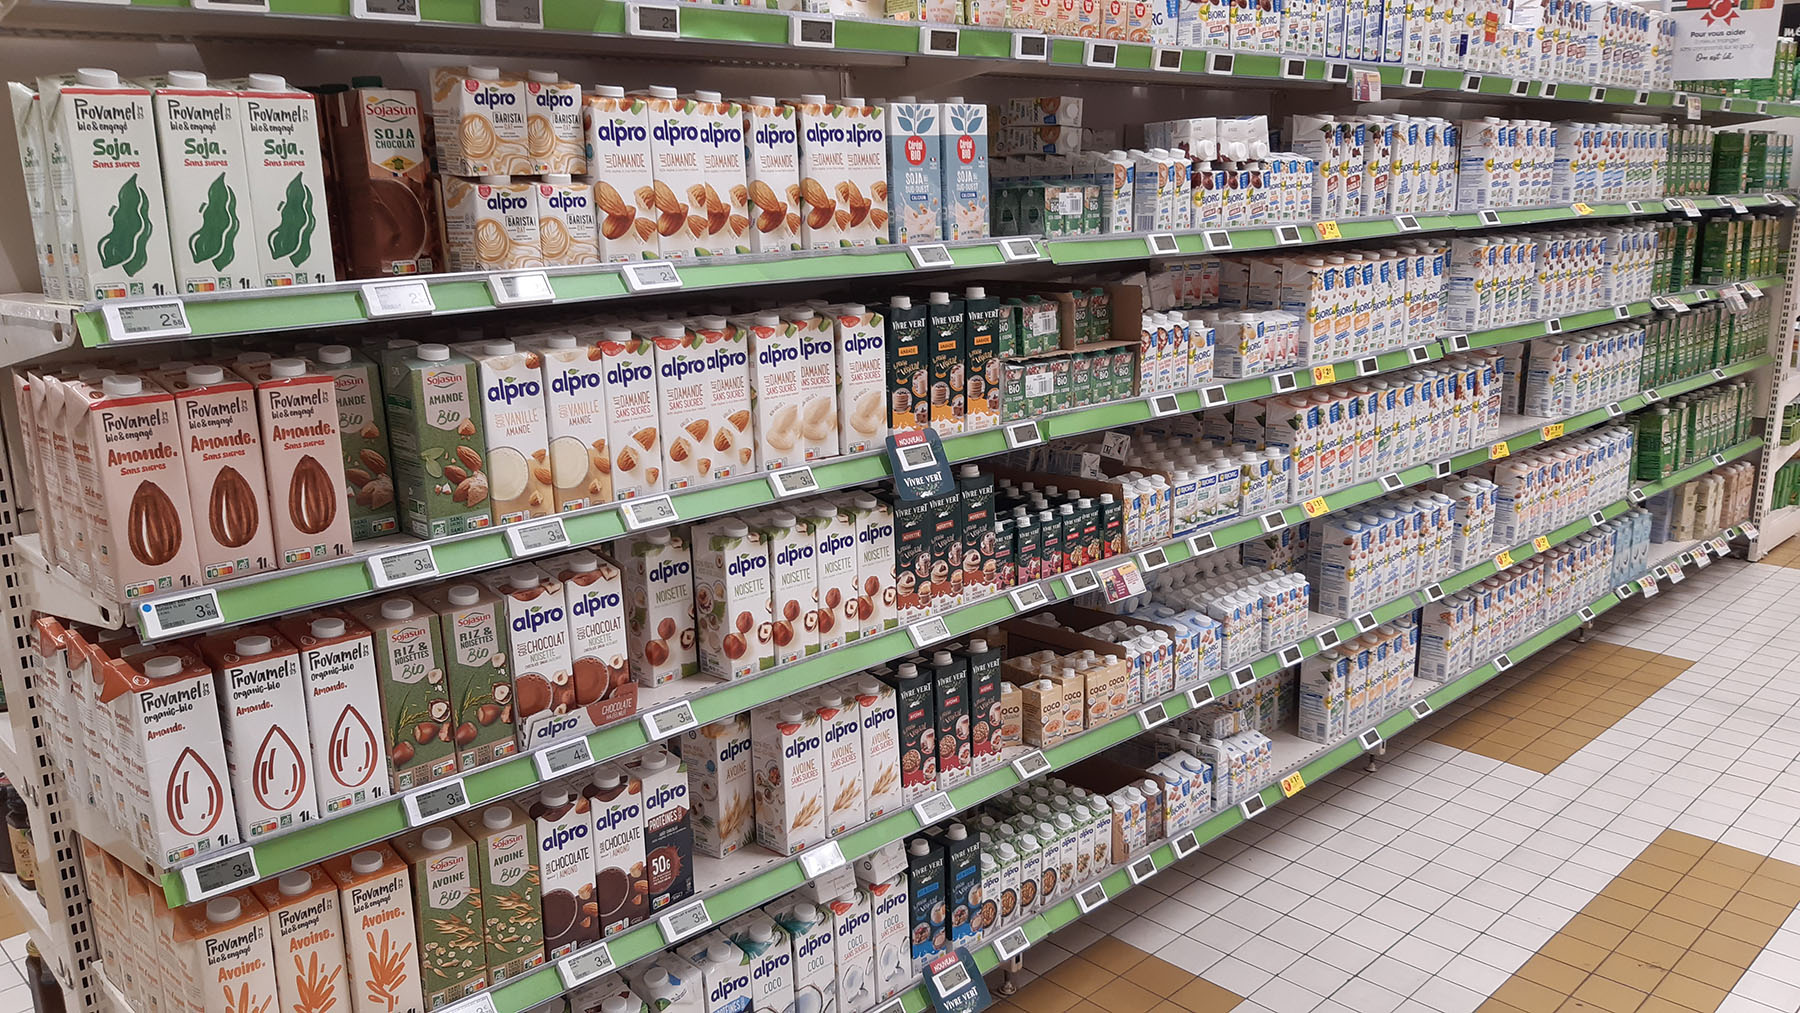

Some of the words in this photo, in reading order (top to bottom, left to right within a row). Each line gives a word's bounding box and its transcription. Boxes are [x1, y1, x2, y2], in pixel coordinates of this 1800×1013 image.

[474, 88, 515, 110] alpro
[536, 90, 574, 110] alpro
[366, 103, 416, 118] Sojasun
[495, 113, 522, 124] BARISTA
[555, 114, 580, 124] BARISTA
[374, 128, 414, 140] SOJA
[598, 119, 646, 146] alpro
[653, 119, 698, 146] alpro
[700, 122, 741, 148] alpro
[756, 124, 795, 149] alpro
[806, 122, 844, 147] alpro
[376, 139, 415, 149] CHOCOLAT
[911, 151, 921, 160] BIO
[962, 150, 970, 159] BIO
[906, 172, 924, 184] SOJA
[957, 171, 973, 182] SOJA
[487, 192, 528, 213] alpro
[550, 191, 586, 212] alpro
[508, 216, 534, 226] BARISTA
[568, 214, 593, 226] BARISTA
[660, 272, 668, 282] 2
[160, 314, 172, 326] 2
[908, 318, 926, 328] VERT
[948, 313, 963, 323] VERT
[426, 374, 462, 386] Sojasun
[552, 371, 600, 396] alpro
[488, 377, 540, 404] alpro
[713, 392, 725, 402] SANS
[726, 390, 744, 400] SUCRES
[430, 392, 464, 405] AMANDE
[670, 400, 682, 410] SANS
[684, 398, 703, 408] SUCRES
[568, 400, 599, 416] VANILLE
[616, 408, 629, 419] SANS
[631, 405, 650, 416] SUCRES
[437, 410, 460, 424] Bio
[505, 409, 538, 426] VANILLE
[569, 416, 592, 426] AMANDE
[506, 424, 531, 436] AMANDE
[899, 436, 923, 445] NOUVEAU
[926, 472, 942, 483] VERT
[659, 506, 666, 516] 3
[549, 531, 556, 541] 3
[864, 546, 890, 562] NOISETTE
[414, 560, 423, 570] 3
[824, 557, 852, 574] NOISETTE
[782, 568, 811, 586] NOISETTE
[656, 584, 688, 603] NOISETTE
[734, 578, 764, 597] NOISETTE
[195, 606, 206, 618] 3
[458, 613, 491, 627] Sojasun
[586, 617, 621, 636] CHOCOLAT
[392, 628, 426, 642] Sojasun
[460, 631, 481, 642] RIZ
[484, 627, 492, 636] &
[460, 635, 494, 649] NOISETTES
[527, 631, 565, 653] CHOCOLAT
[394, 646, 416, 658] RIZ
[419, 642, 428, 652] &
[468, 648, 488, 662] Bio
[394, 650, 430, 666] NOISETTES
[402, 664, 424, 679] Bio
[917, 683, 931, 693] VERT
[1108, 676, 1125, 686] COCO
[1064, 691, 1082, 701] COCO
[1090, 686, 1107, 696] COCO
[602, 698, 632, 716] CHOCOLATE
[1043, 702, 1060, 714] COCO
[871, 729, 890, 746] AVOINE
[574, 749, 581, 759] 4
[832, 743, 854, 760] AVOINE
[727, 761, 746, 778] AVOINE
[792, 760, 816, 776] AVOINE
[447, 792, 456, 805] 3
[492, 834, 523, 849] Sojasun
[604, 828, 640, 852] CHOCOLATE
[430, 856, 464, 871] Sojasun
[494, 850, 524, 866] AVOINE
[551, 848, 590, 873] CHOCOLATE
[233, 864, 243, 878] 3
[500, 867, 520, 882] Bio
[432, 872, 464, 890] AVOINE
[439, 890, 460, 905] Bio
[884, 914, 898, 928] COCO
[848, 935, 863, 950] COCO
[808, 956, 824, 972] COCO
[934, 956, 956, 972] NOUVEAU
[764, 977, 782, 994] COCO
[961, 987, 978, 1001] VERT
